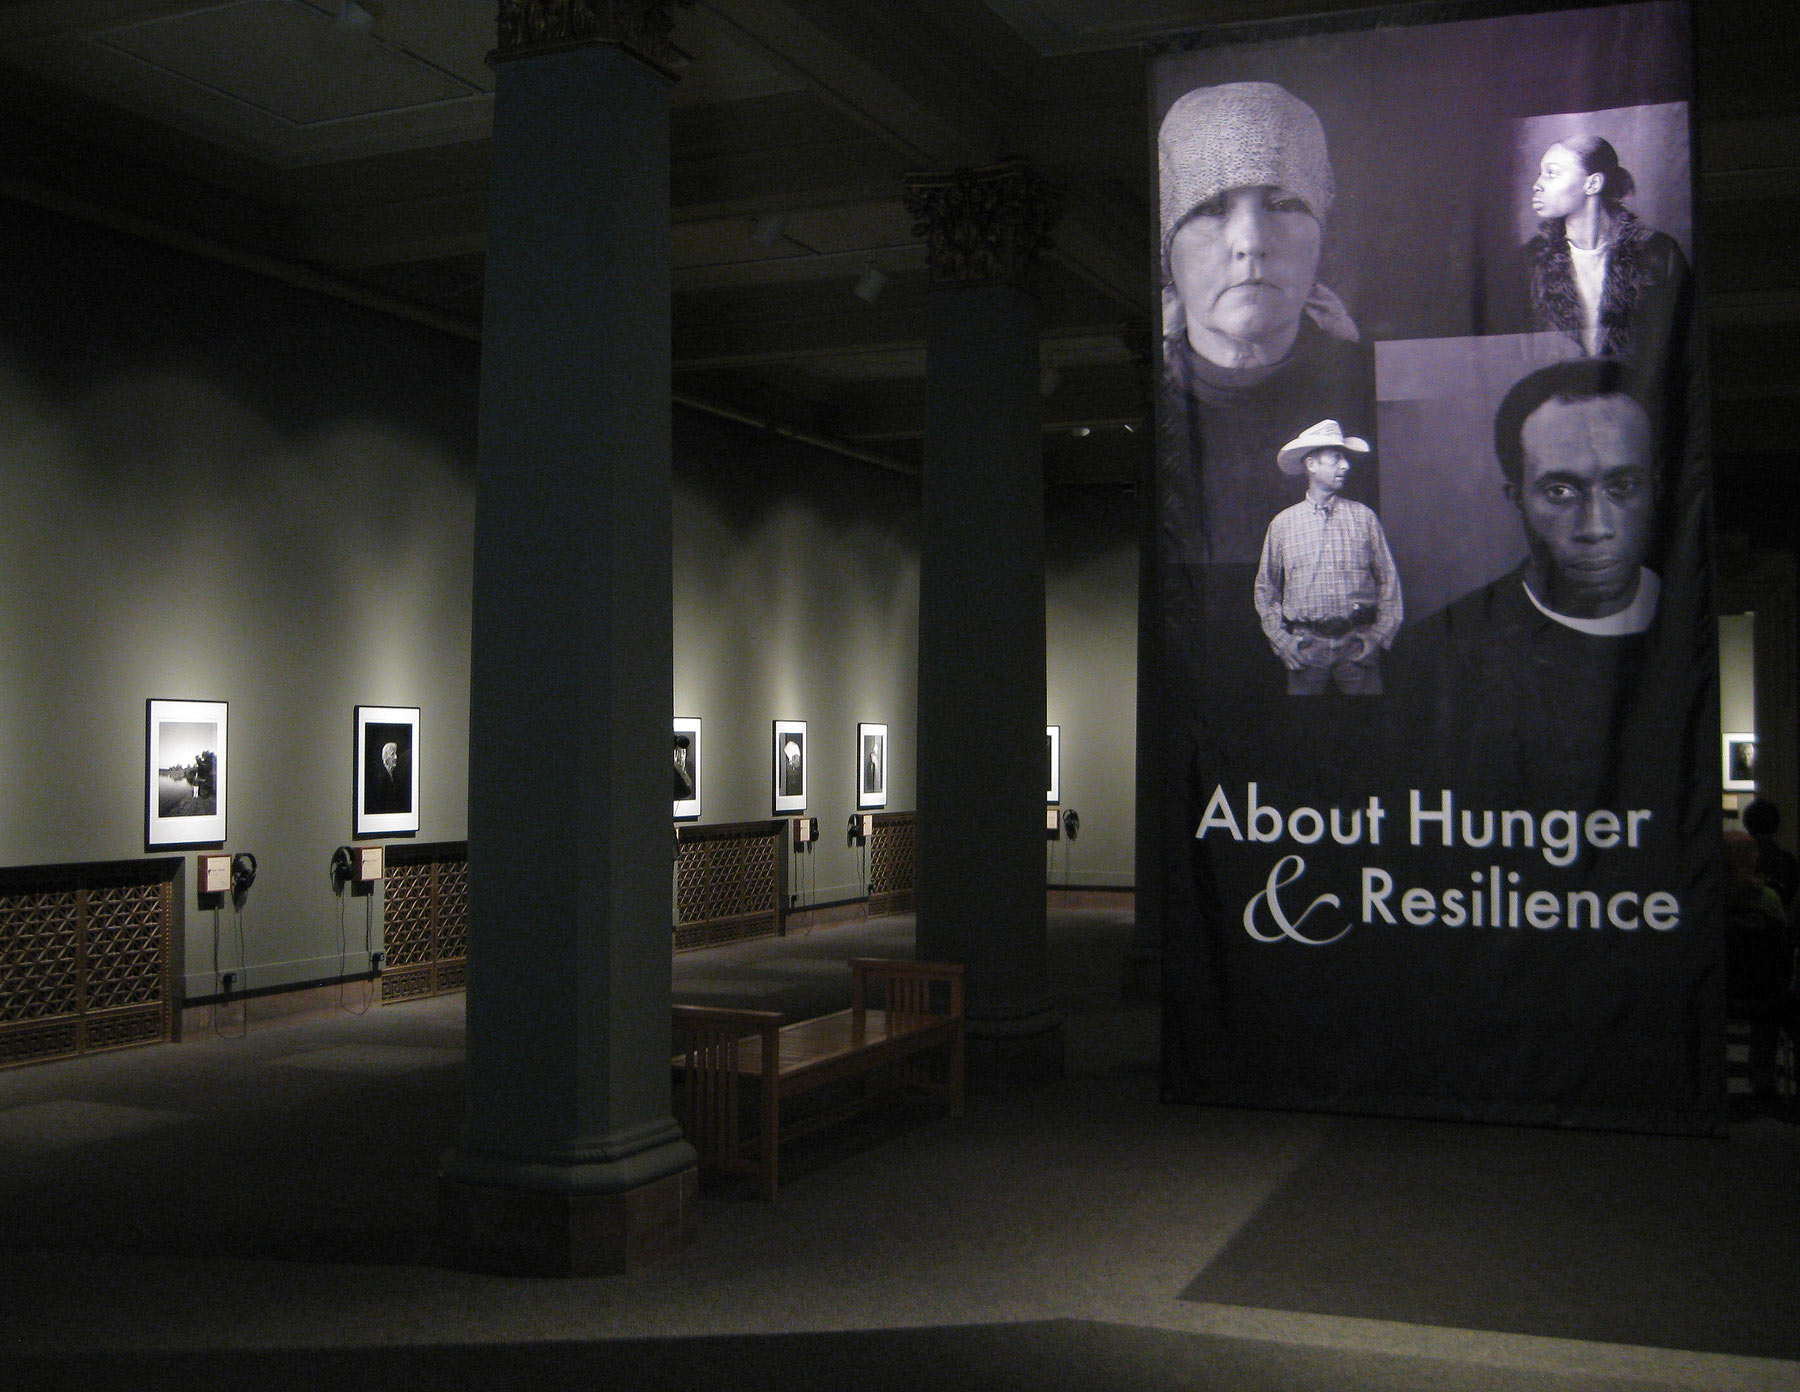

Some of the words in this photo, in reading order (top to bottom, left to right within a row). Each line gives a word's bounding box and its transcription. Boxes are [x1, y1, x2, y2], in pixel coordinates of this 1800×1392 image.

[1195, 781, 1386, 845] About
[1410, 789, 1653, 867] Hunger
[1243, 855, 1353, 945] &
[1361, 866, 1681, 931] Resilience
